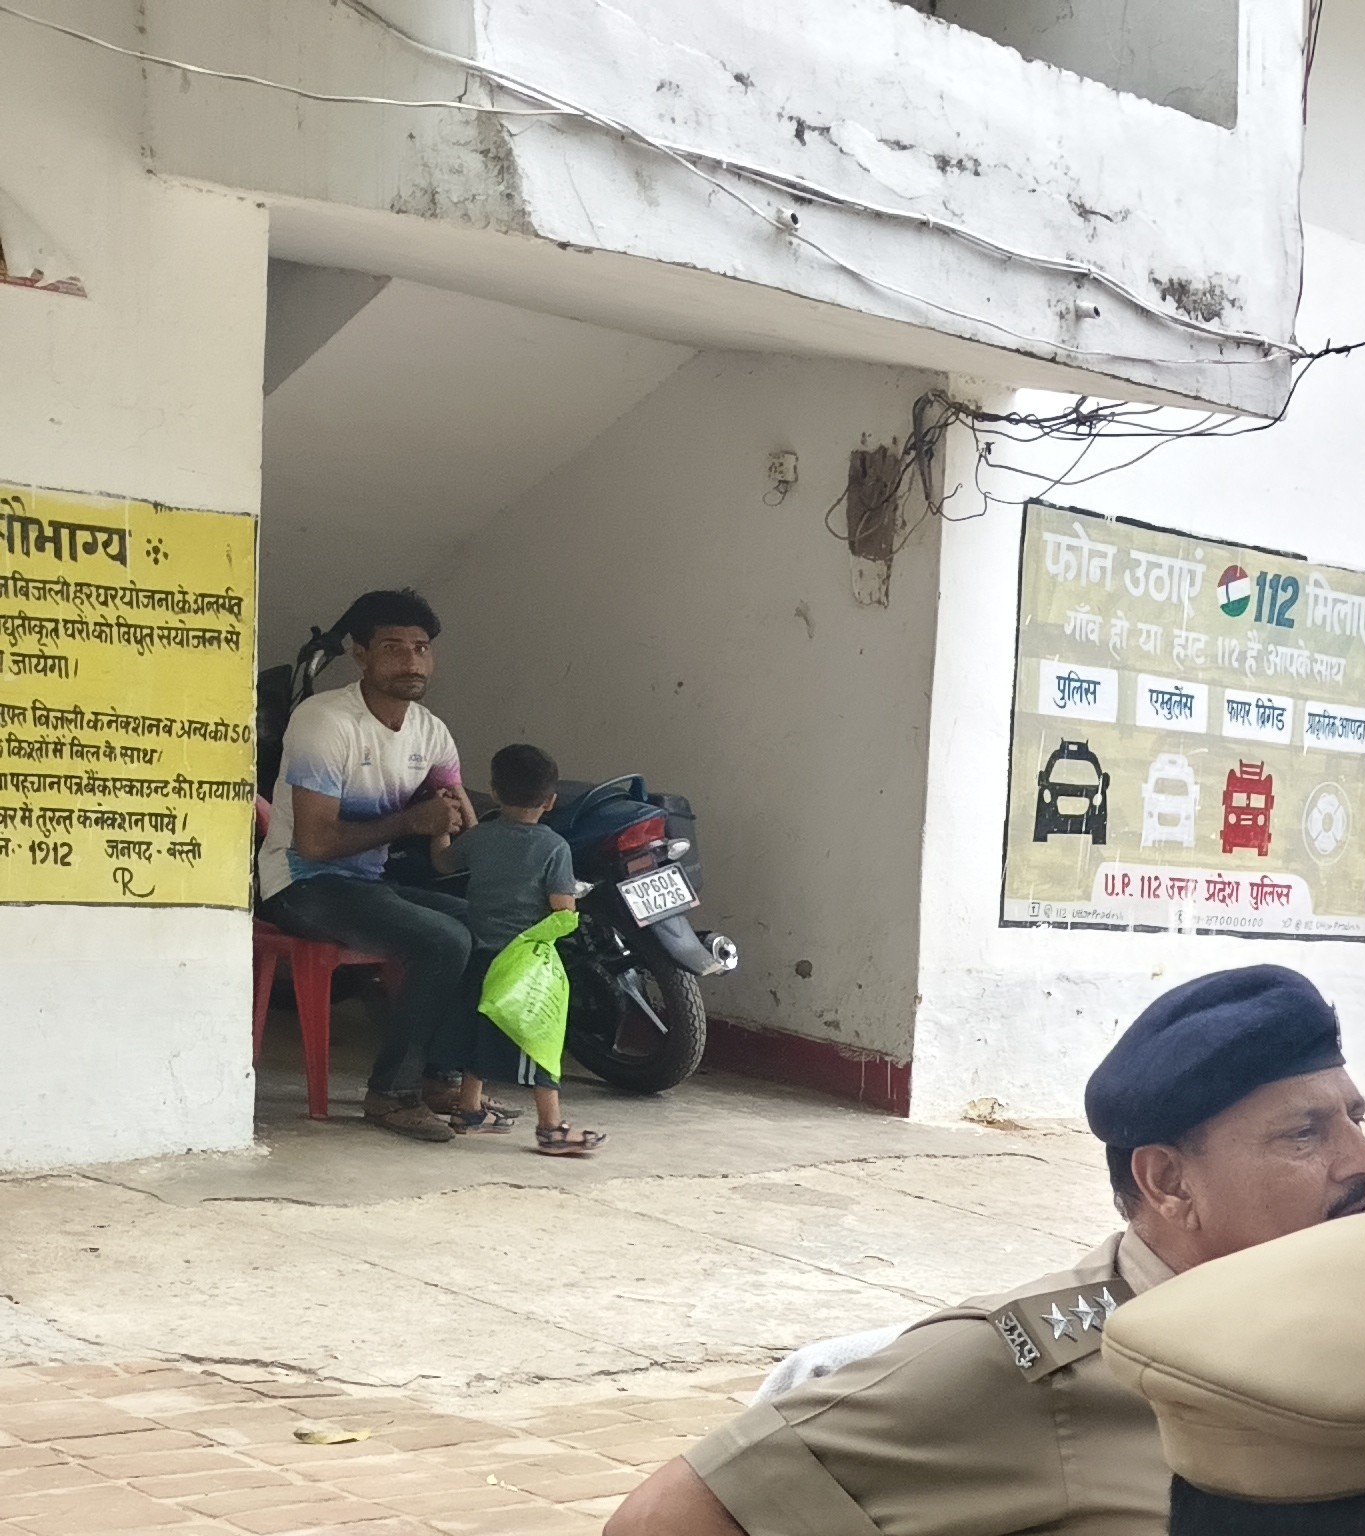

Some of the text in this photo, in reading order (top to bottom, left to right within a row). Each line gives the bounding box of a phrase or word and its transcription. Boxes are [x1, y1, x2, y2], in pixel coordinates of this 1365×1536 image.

[11, 569, 71, 606] बिजली
[72, 582, 96, 613] हर
[96, 584, 119, 611] घर
[119, 580, 175, 612] योजना
[176, 583, 191, 613] के
[1043, 521, 1118, 592] फोन
[1123, 546, 1207, 618] उठाएं
[1253, 570, 1300, 629] 112
[62, 614, 90, 642] घरों
[92, 614, 114, 645] को
[116, 615, 154, 656] विद्युत
[157, 619, 222, 650] संयोजन
[224, 623, 242, 652] से
[1109, 609, 1130, 662] हो
[1137, 621, 1163, 656] या
[1216, 635, 1240, 669] 112
[1264, 638, 1311, 680] आपके
[1312, 652, 1347, 686] साथ
[1053, 670, 1101, 709] पुलिस
[31, 698, 85, 733] बिजली
[176, 719, 211, 742] अन्य
[209, 716, 231, 742] को
[230, 723, 252, 743] 50
[1226, 698, 1252, 727] फायर
[52, 733, 66, 760] में
[69, 735, 101, 763] बिल
[103, 740, 117, 763] के
[10, 772, 62, 800] पहचान
[64, 774, 84, 796] पत्र
[84, 769, 111, 797] बैंक
[171, 772, 194, 800] की
[19, 801, 33, 829] में
[36, 806, 74, 838] तुरन्त
[28, 839, 73, 867] 1912
[104, 839, 153, 865] जनपद
[166, 836, 202, 869] बस्ती
[633, 873, 679, 899] UP60A
[641, 887, 686, 914] N4736
[1104, 872, 1134, 898] U.P.
[1140, 875, 1162, 899] 112
[1204, 872, 1241, 908] प्रदेश
[1249, 874, 1293, 912] पुलिस
